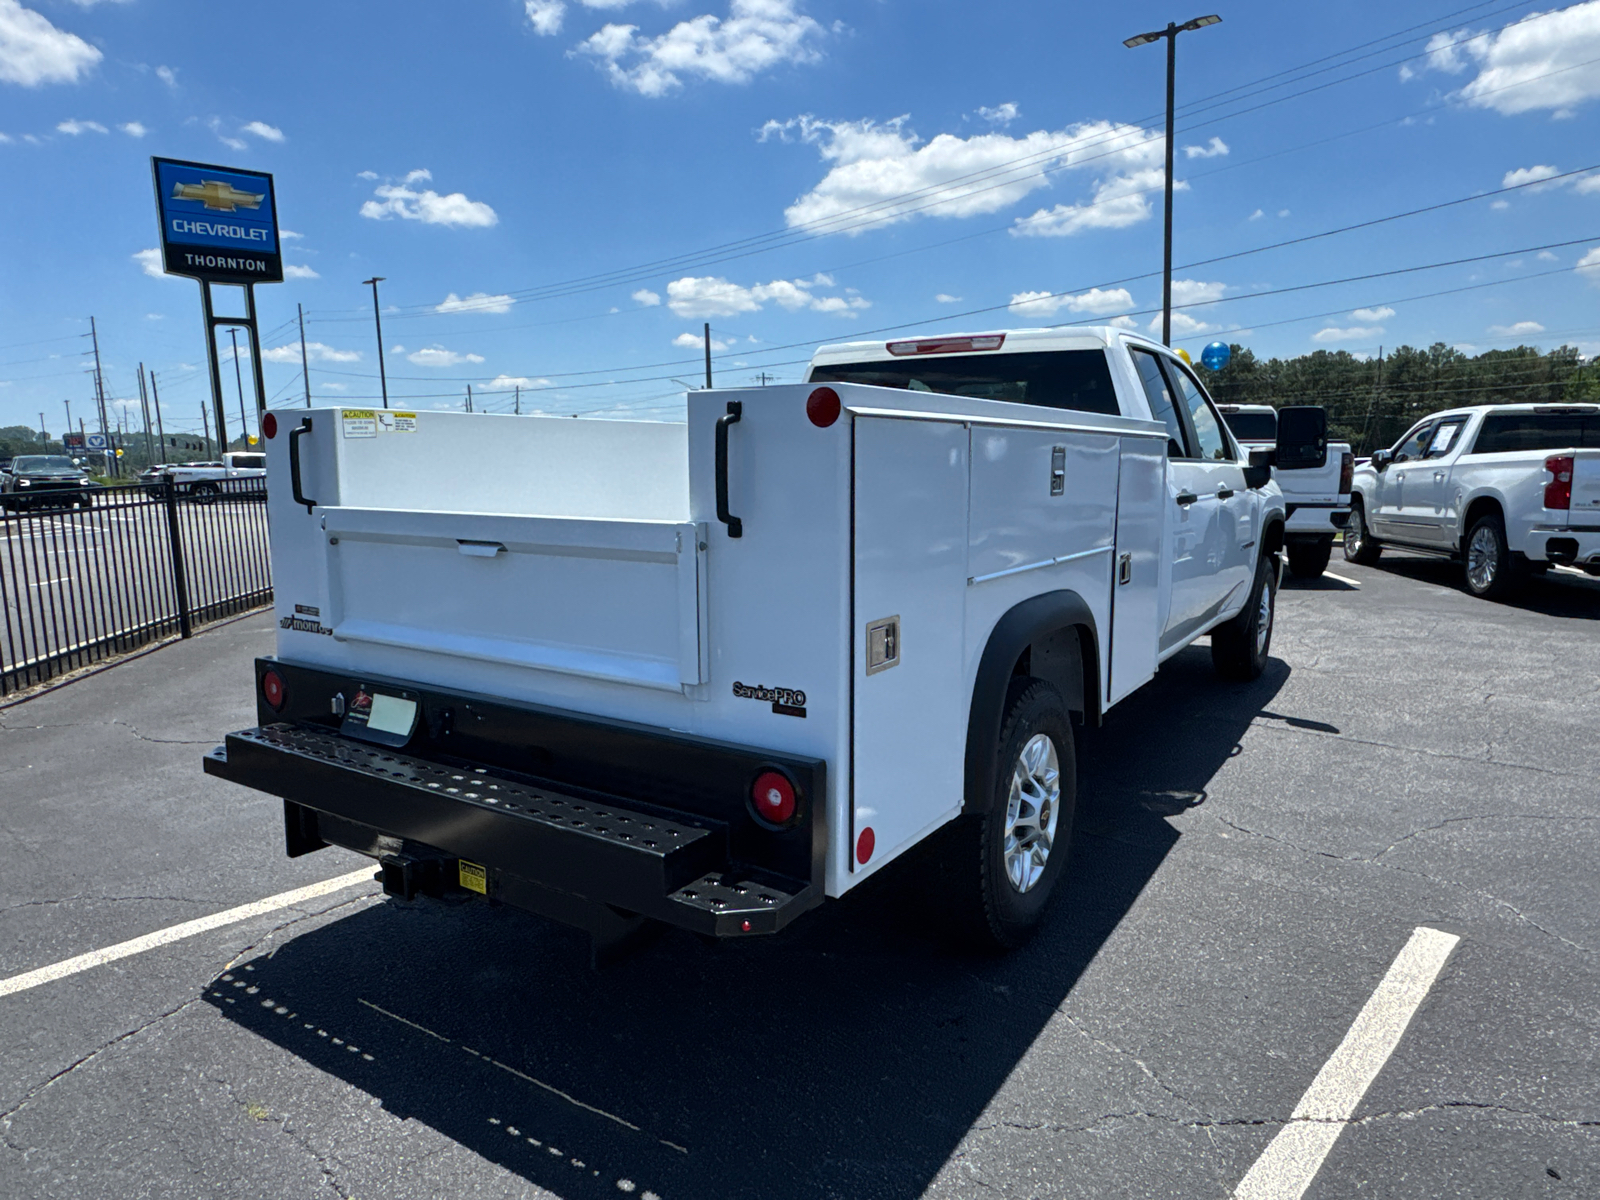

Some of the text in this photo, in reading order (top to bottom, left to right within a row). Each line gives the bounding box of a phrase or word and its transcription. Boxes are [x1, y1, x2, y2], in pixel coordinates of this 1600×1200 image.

[172, 219, 269, 241] CHEVROLET
[185, 254, 266, 272] THORNTON
[733, 681, 806, 706] ServicePRO
[461, 864, 485, 878] CAUTION
